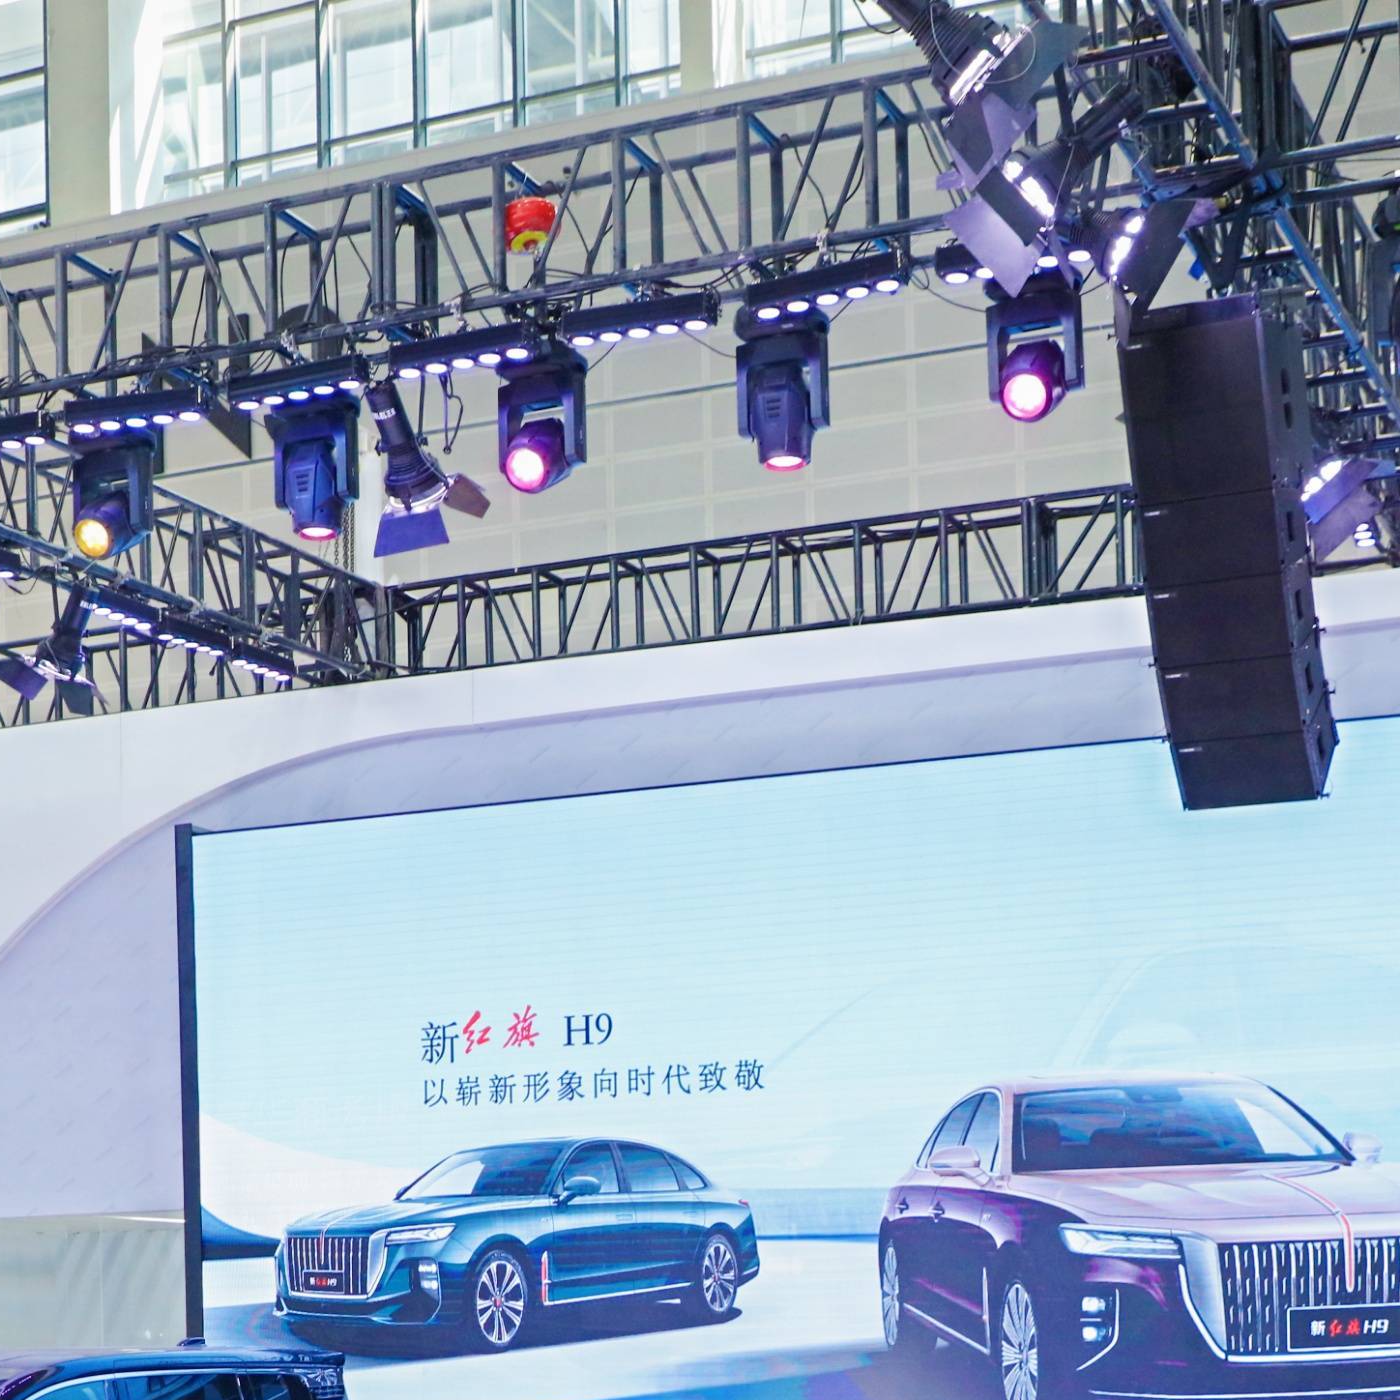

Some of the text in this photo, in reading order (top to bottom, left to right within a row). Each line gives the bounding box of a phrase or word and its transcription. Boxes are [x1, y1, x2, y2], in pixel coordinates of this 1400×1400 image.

[563, 1012, 613, 1047] H9
[423, 1058, 766, 1108] 以崭新形象向时代致敬
